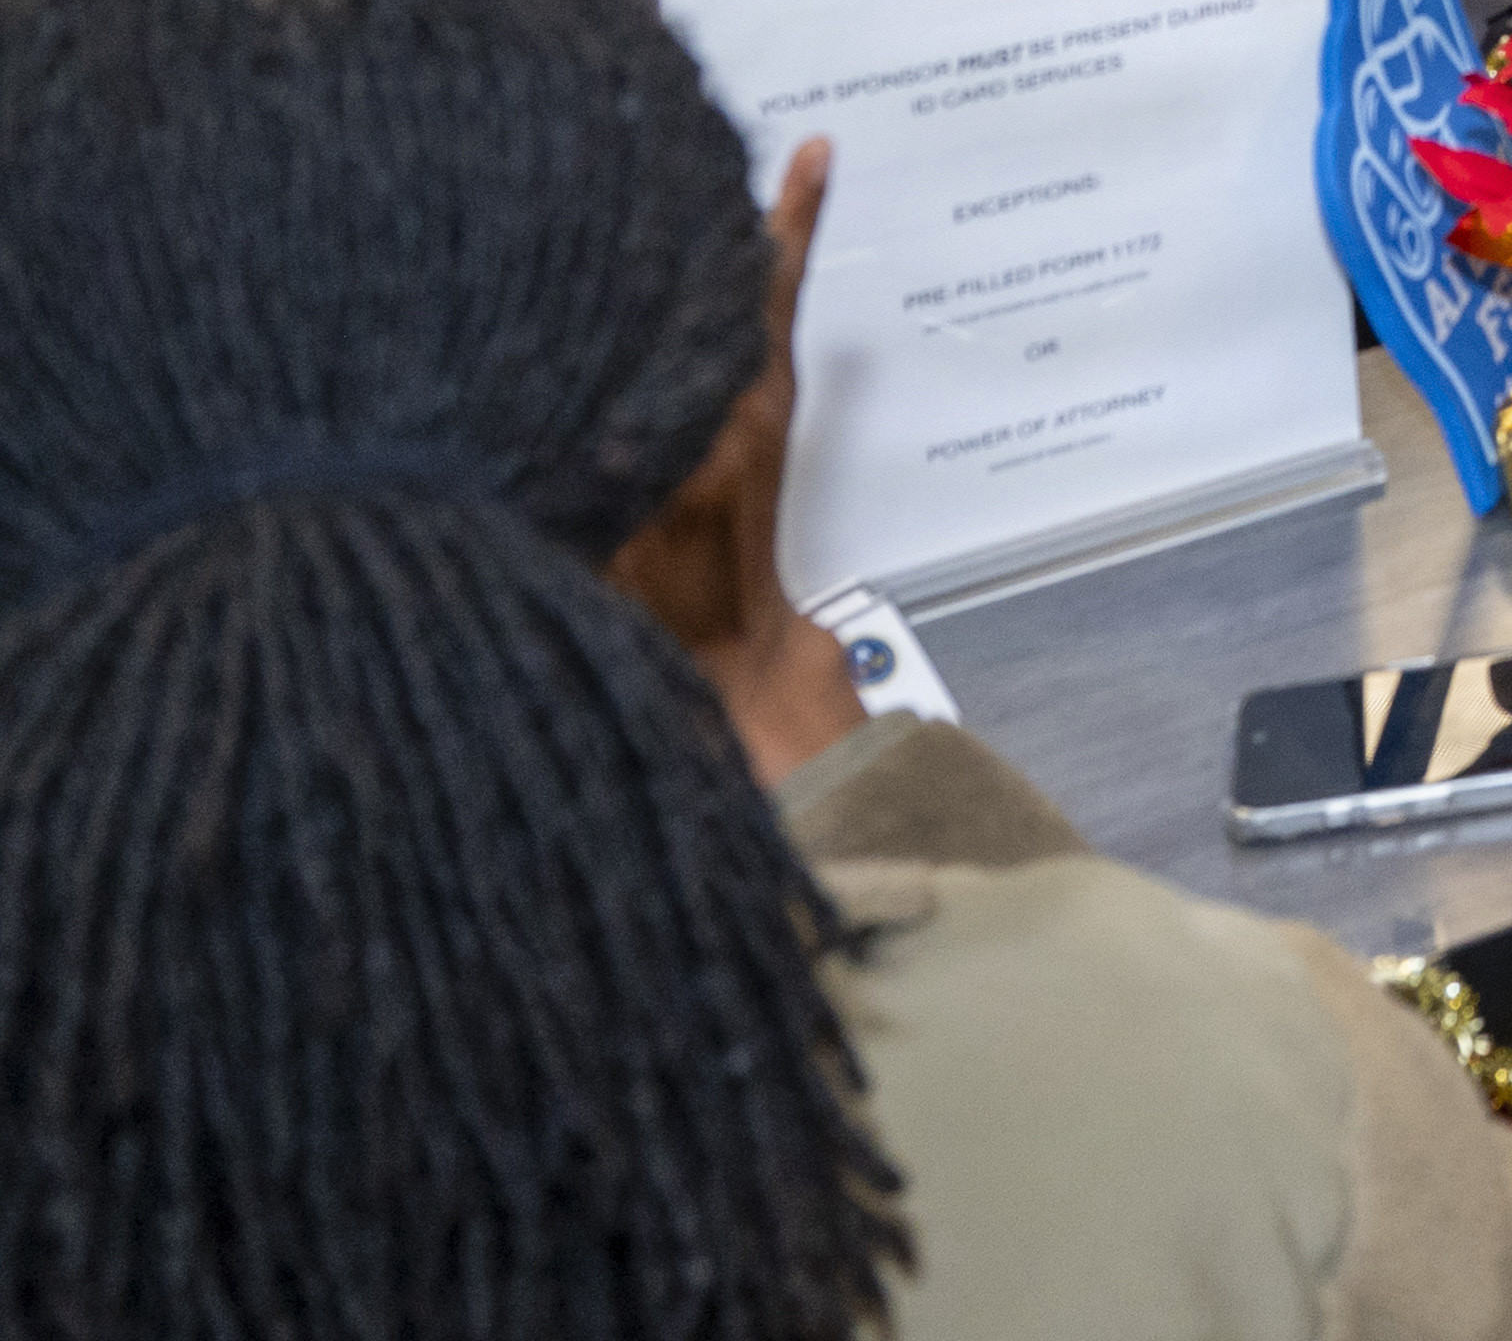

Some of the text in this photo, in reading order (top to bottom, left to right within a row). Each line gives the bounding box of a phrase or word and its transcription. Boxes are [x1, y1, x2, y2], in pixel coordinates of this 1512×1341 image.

[758, 86, 828, 119] YOUR
[833, 61, 952, 100] SPONSOR
[957, 43, 1025, 72] MUST
[1029, 36, 1057, 56] BE
[1062, 14, 1163, 49] PRESENT
[912, 55, 1125, 115] ID CARD SERVICES
[1037, 248, 1104, 282] FORM
[1025, 338, 1060, 362] OR
[926, 426, 1013, 462] POWER
[1018, 415, 1048, 440] OF
[1053, 386, 1166, 429] ATTORNEY
